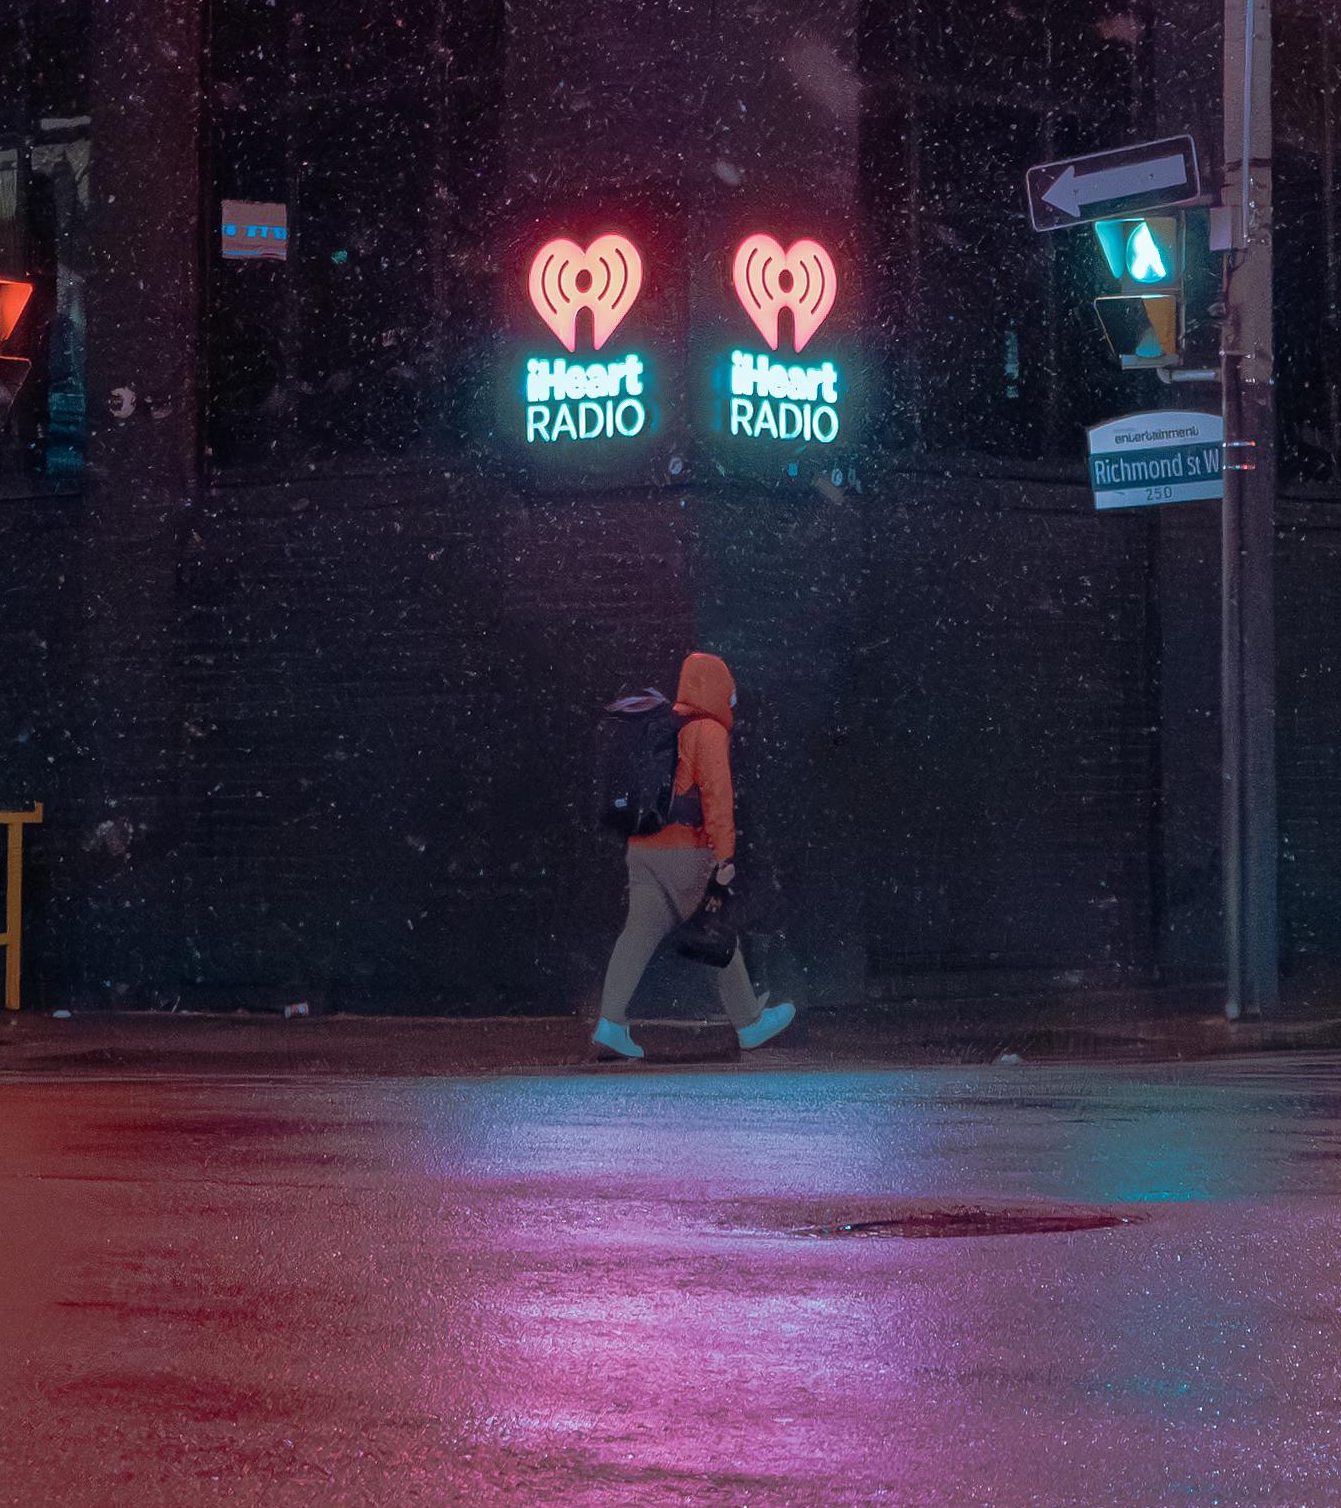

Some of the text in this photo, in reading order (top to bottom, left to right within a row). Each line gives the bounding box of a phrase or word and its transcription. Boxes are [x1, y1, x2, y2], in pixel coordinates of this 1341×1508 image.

[526, 353, 644, 403] iHeart
[730, 349, 838, 404] iHeart
[526, 398, 645, 443] RADIO
[730, 397, 839, 443] RADIO
[1114, 425, 1200, 445] entertainment
[1093, 448, 1220, 485] Richmond St W
[1145, 485, 1173, 501] 250
